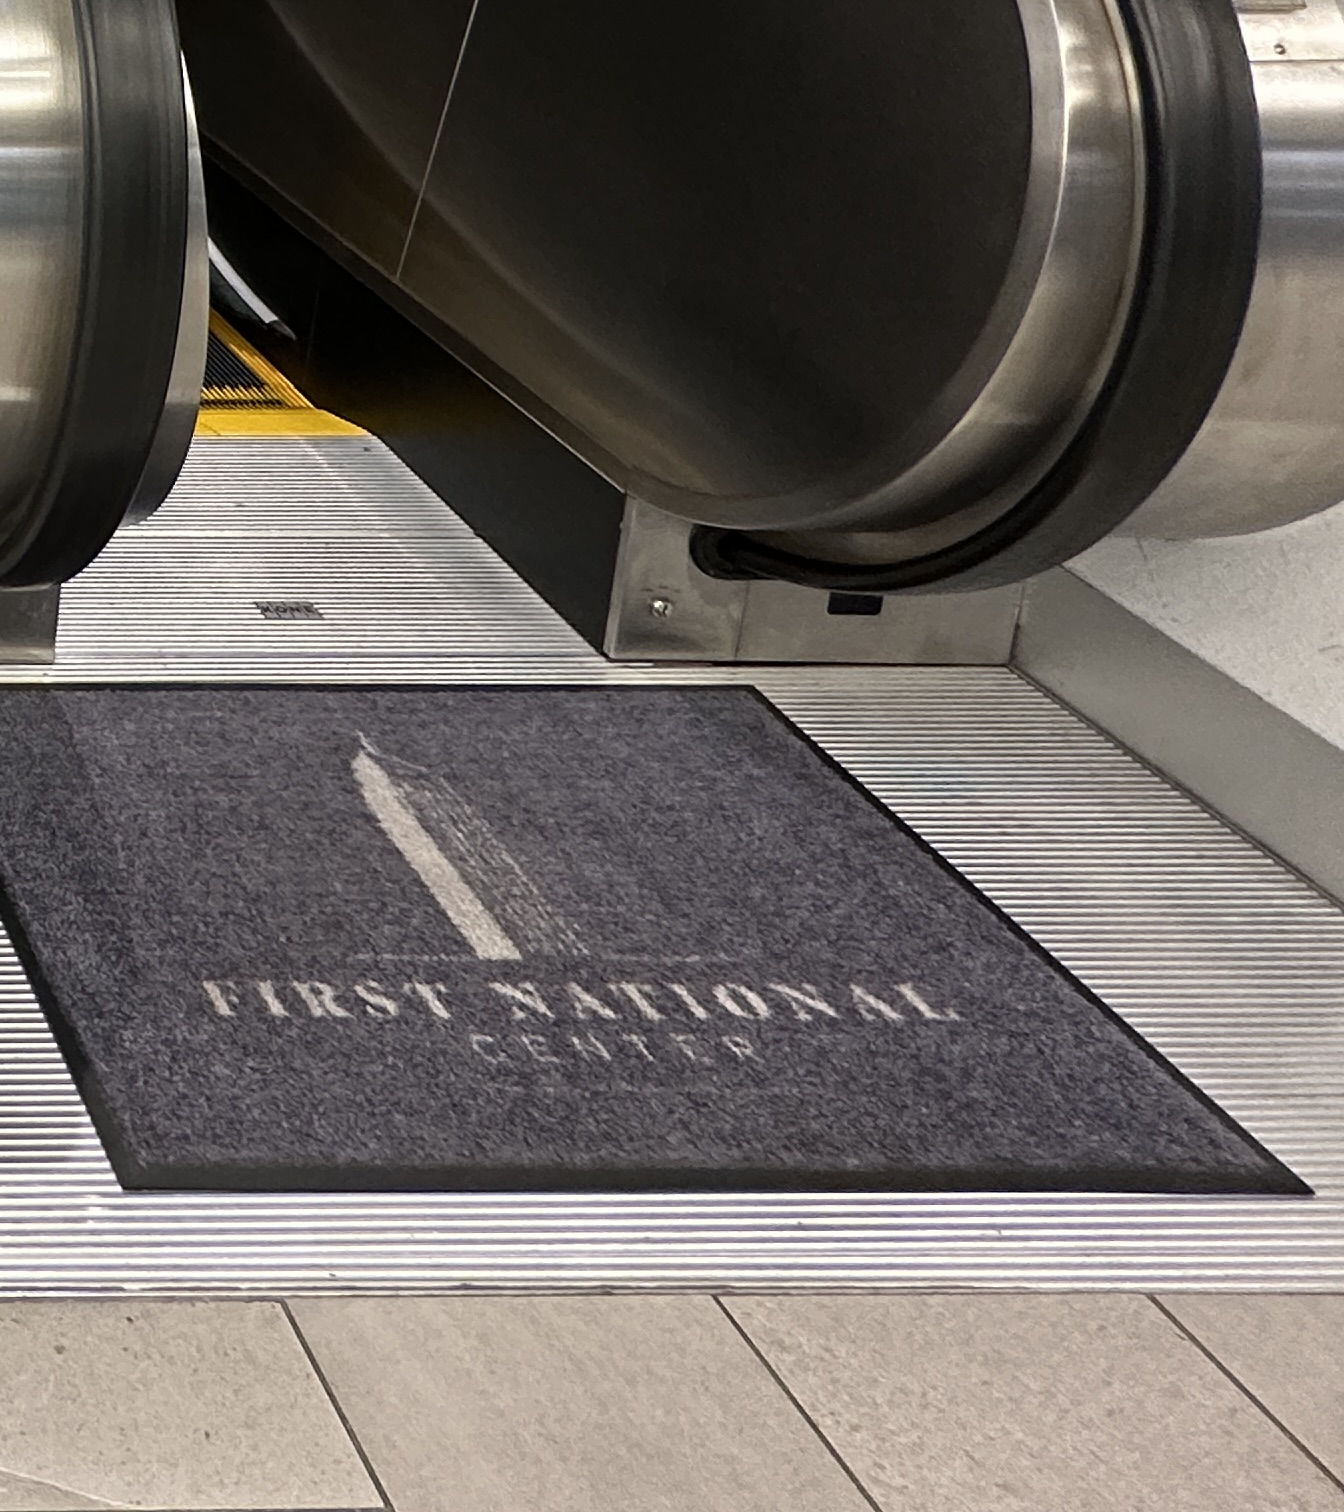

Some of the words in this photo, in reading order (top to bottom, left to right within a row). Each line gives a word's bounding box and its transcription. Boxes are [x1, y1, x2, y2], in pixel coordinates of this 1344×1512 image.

[202, 979, 451, 1019] FIRST
[488, 980, 962, 1021] NATIONAL
[469, 1031, 765, 1065] CENTER
